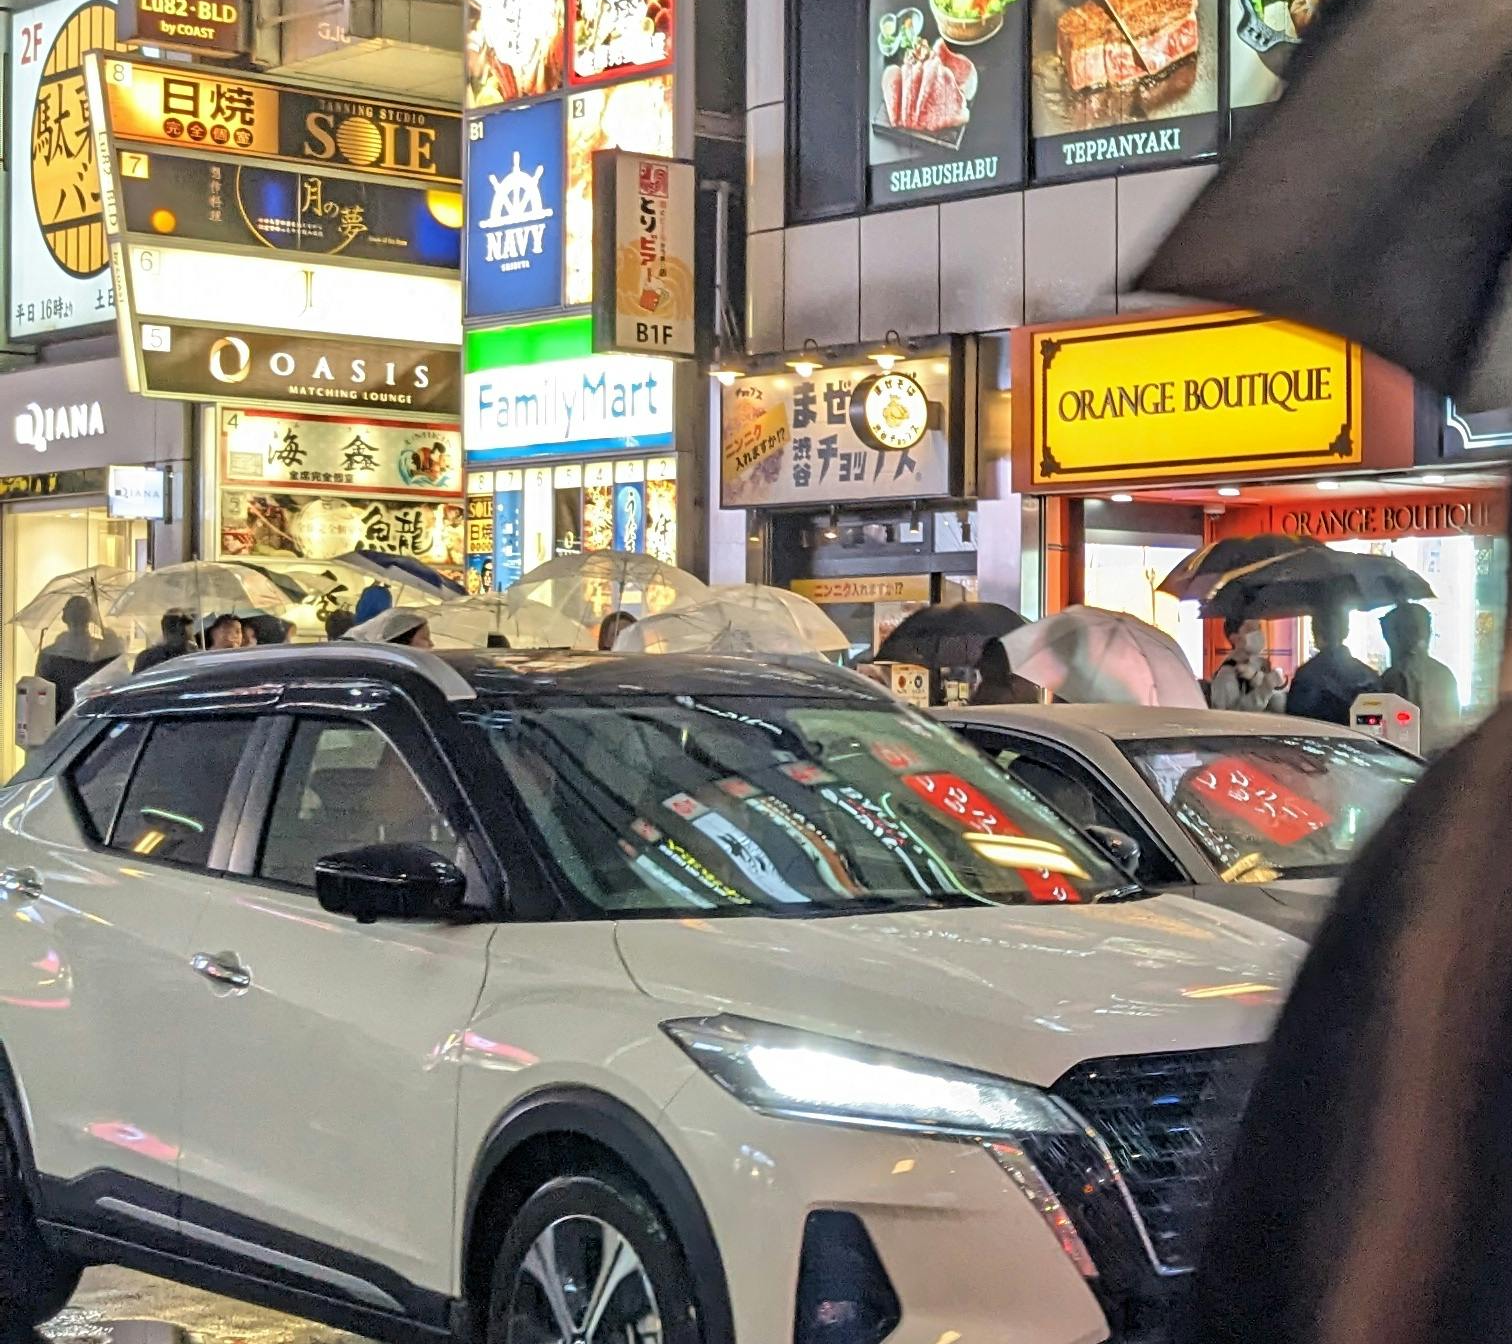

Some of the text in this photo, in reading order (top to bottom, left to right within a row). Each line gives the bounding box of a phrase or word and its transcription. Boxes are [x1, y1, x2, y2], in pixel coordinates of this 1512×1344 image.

[21, 22, 43, 65] 2F
[160, 19, 216, 40] by COAST
[113, 63, 125, 83] 8
[163, 77, 255, 128] 日焼
[321, 98, 426, 126] TANNING STUDIO
[574, 100, 584, 117] 2
[469, 121, 484, 141] B1
[1062, 128, 1181, 166] TEPPANYAKI
[128, 156, 141, 174] 7
[889, 156, 998, 193] SHABUSHABU
[303, 177, 369, 240] 月の夢
[485, 223, 546, 262] NAVY
[140, 250, 153, 275] 6
[15, 304, 35, 325] 平日
[150, 328, 163, 348] 5
[636, 322, 673, 346] B1F
[269, 351, 430, 389] OASIS
[288, 384, 413, 405] MATCHING LOUNGE
[478, 371, 658, 439] FamilyMart
[1057, 366, 1333, 423] ORANGE BOUTIQUE
[227, 413, 239, 430] 4
[725, 424, 762, 458] ニンニク
[792, 435, 812, 488] 渋谷
[119, 486, 160, 499] QIANA
[1281, 505, 1376, 538] ORANGE
